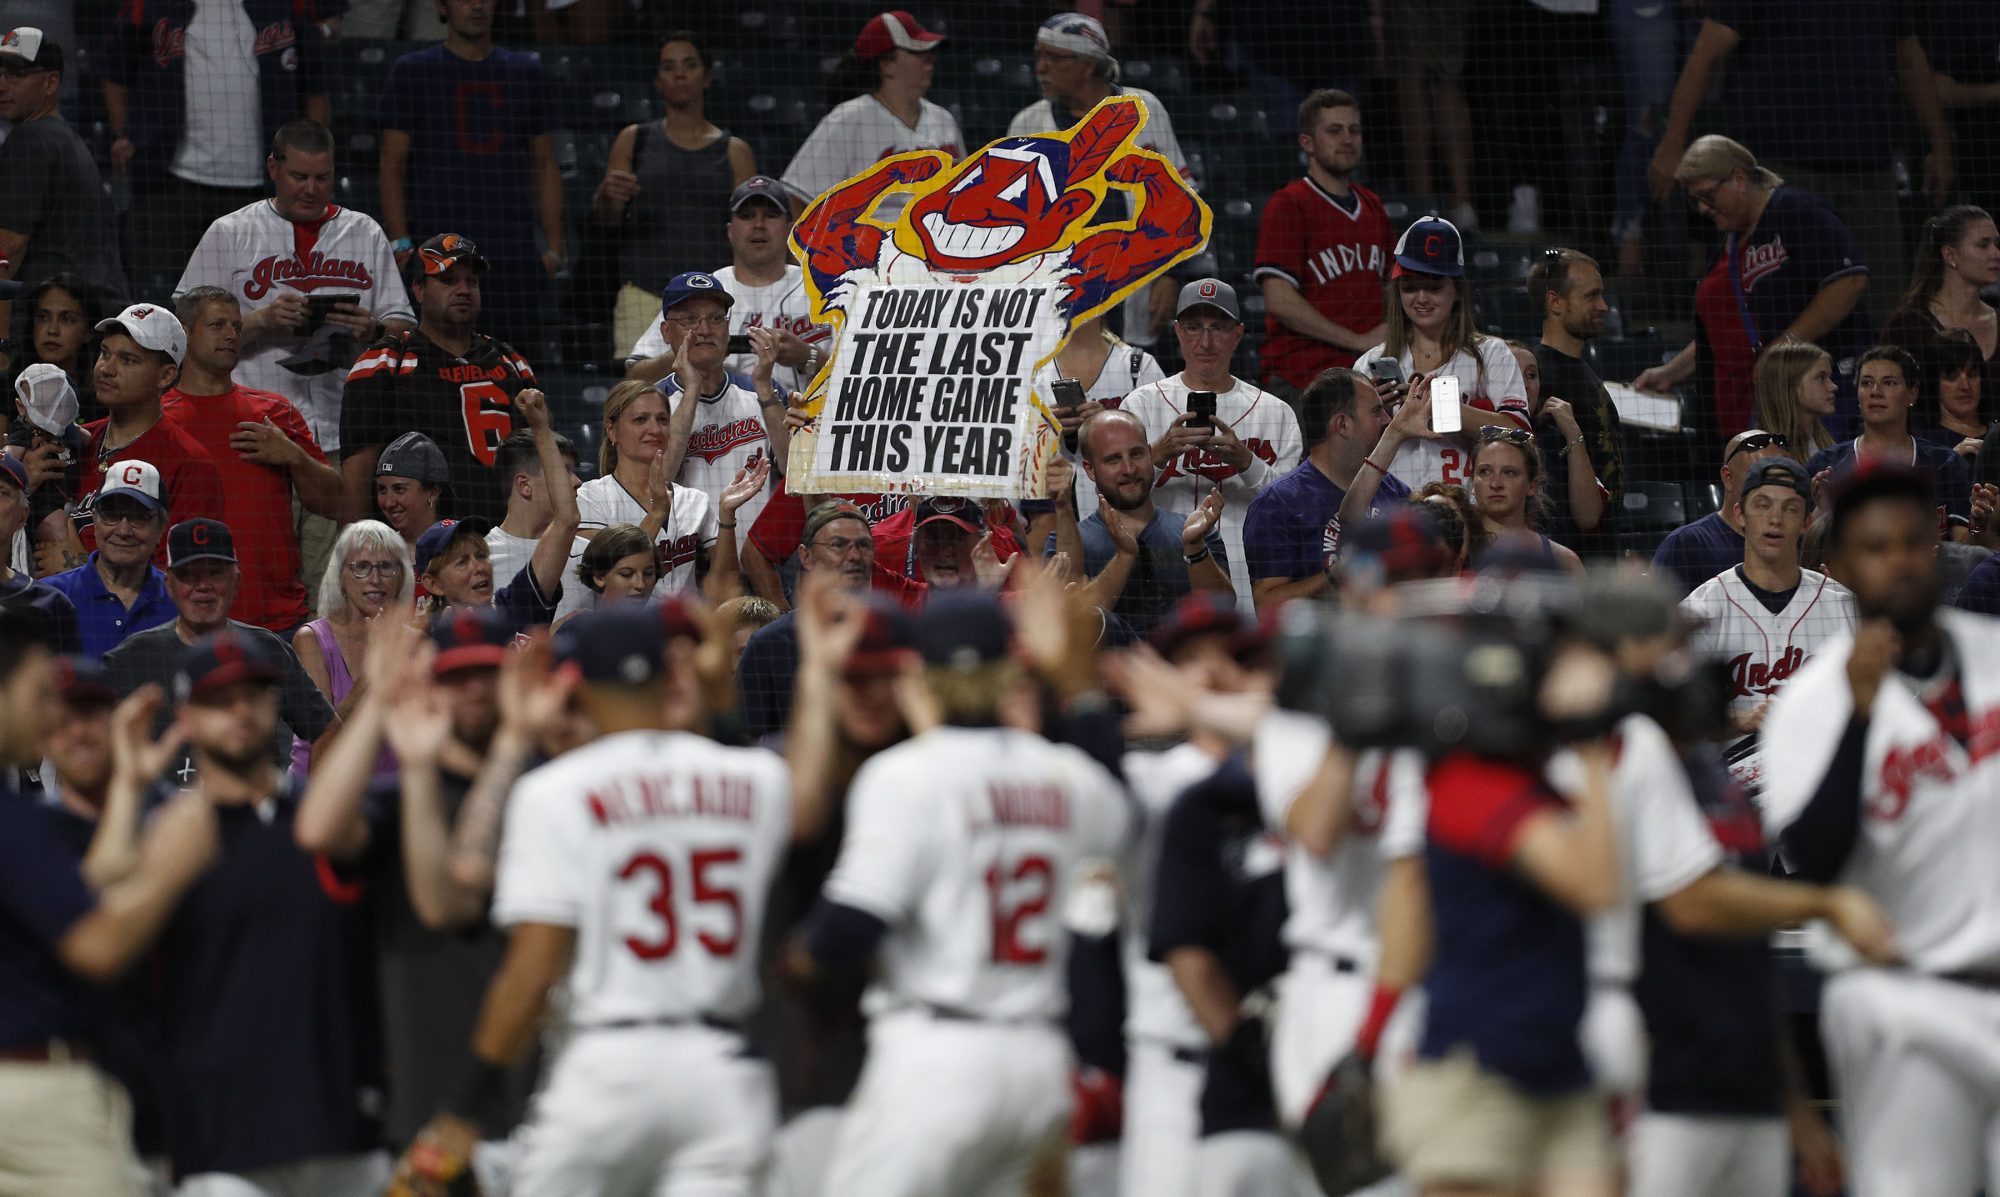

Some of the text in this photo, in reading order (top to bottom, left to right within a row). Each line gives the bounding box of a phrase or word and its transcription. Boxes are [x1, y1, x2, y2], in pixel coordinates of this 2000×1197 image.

[454, 80, 503, 154] C
[1424, 235, 1441, 256] C
[244, 251, 373, 300] Indians
[1198, 280, 1218, 299] O
[861, 288, 953, 330] TODAY
[950, 288, 985, 330] IS
[983, 288, 1047, 329] NOT
[850, 332, 1033, 377] THE LAST
[460, 381, 511, 466] 6
[834, 376, 1022, 424] HOME GAME
[686, 417, 768, 464] ndians
[830, 423, 1013, 477] THIS YEAR
[123, 466, 142, 485] C
[192, 525, 209, 544] C
[618, 848, 744, 960] 35
[985, 854, 1055, 965] 12
